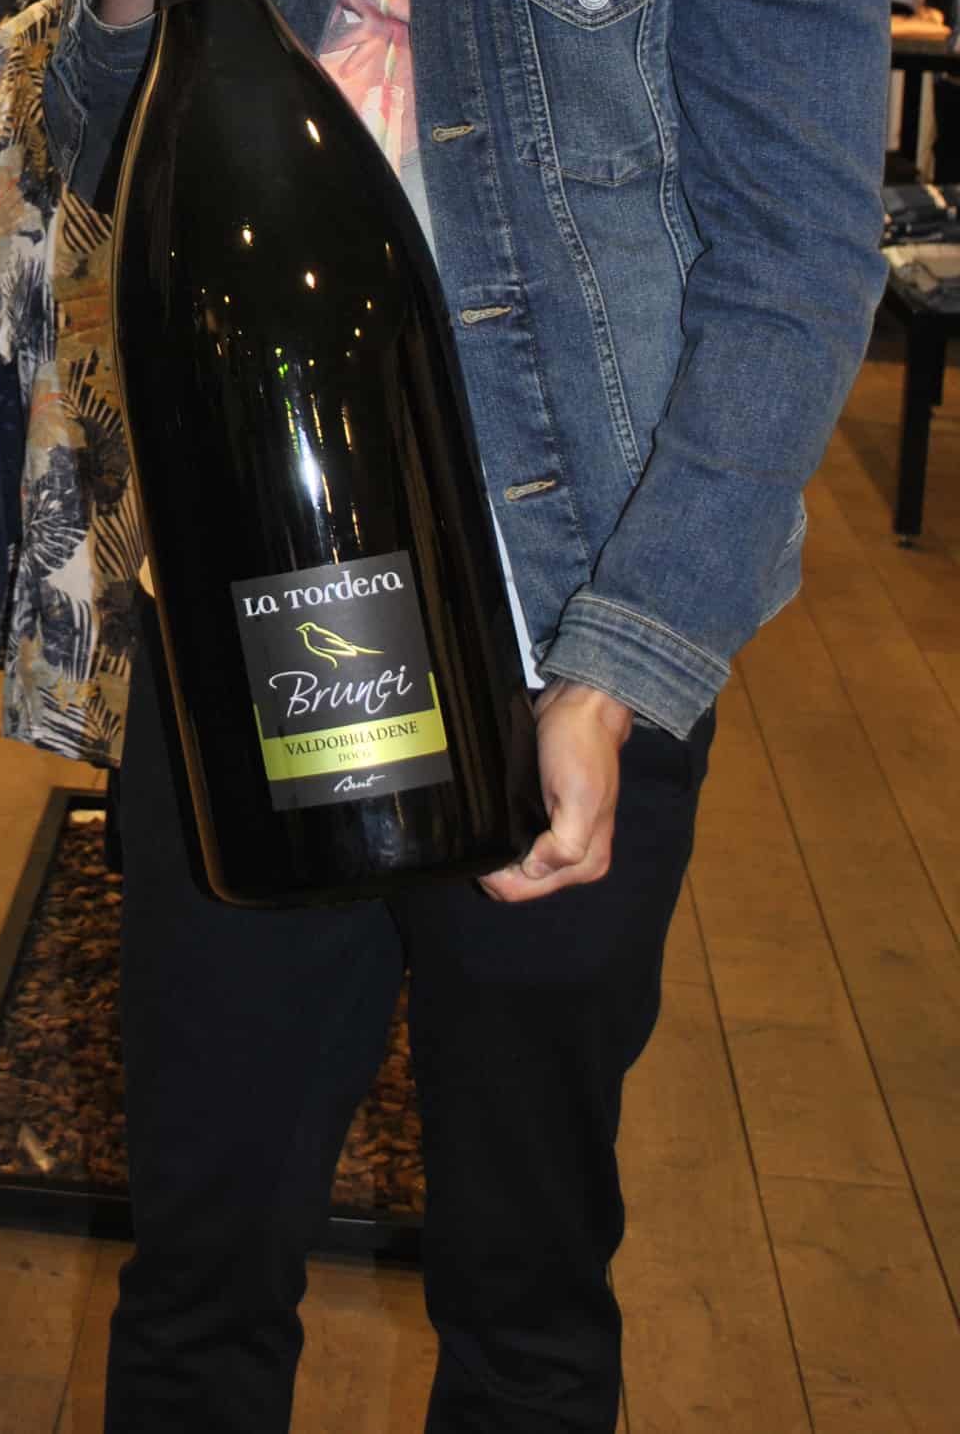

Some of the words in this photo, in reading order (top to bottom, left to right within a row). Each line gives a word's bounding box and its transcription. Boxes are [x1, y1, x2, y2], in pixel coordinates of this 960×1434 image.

[284, 570, 404, 609] Tordera
[269, 665, 413, 718] Brunei
[334, 773, 386, 792] Brut
